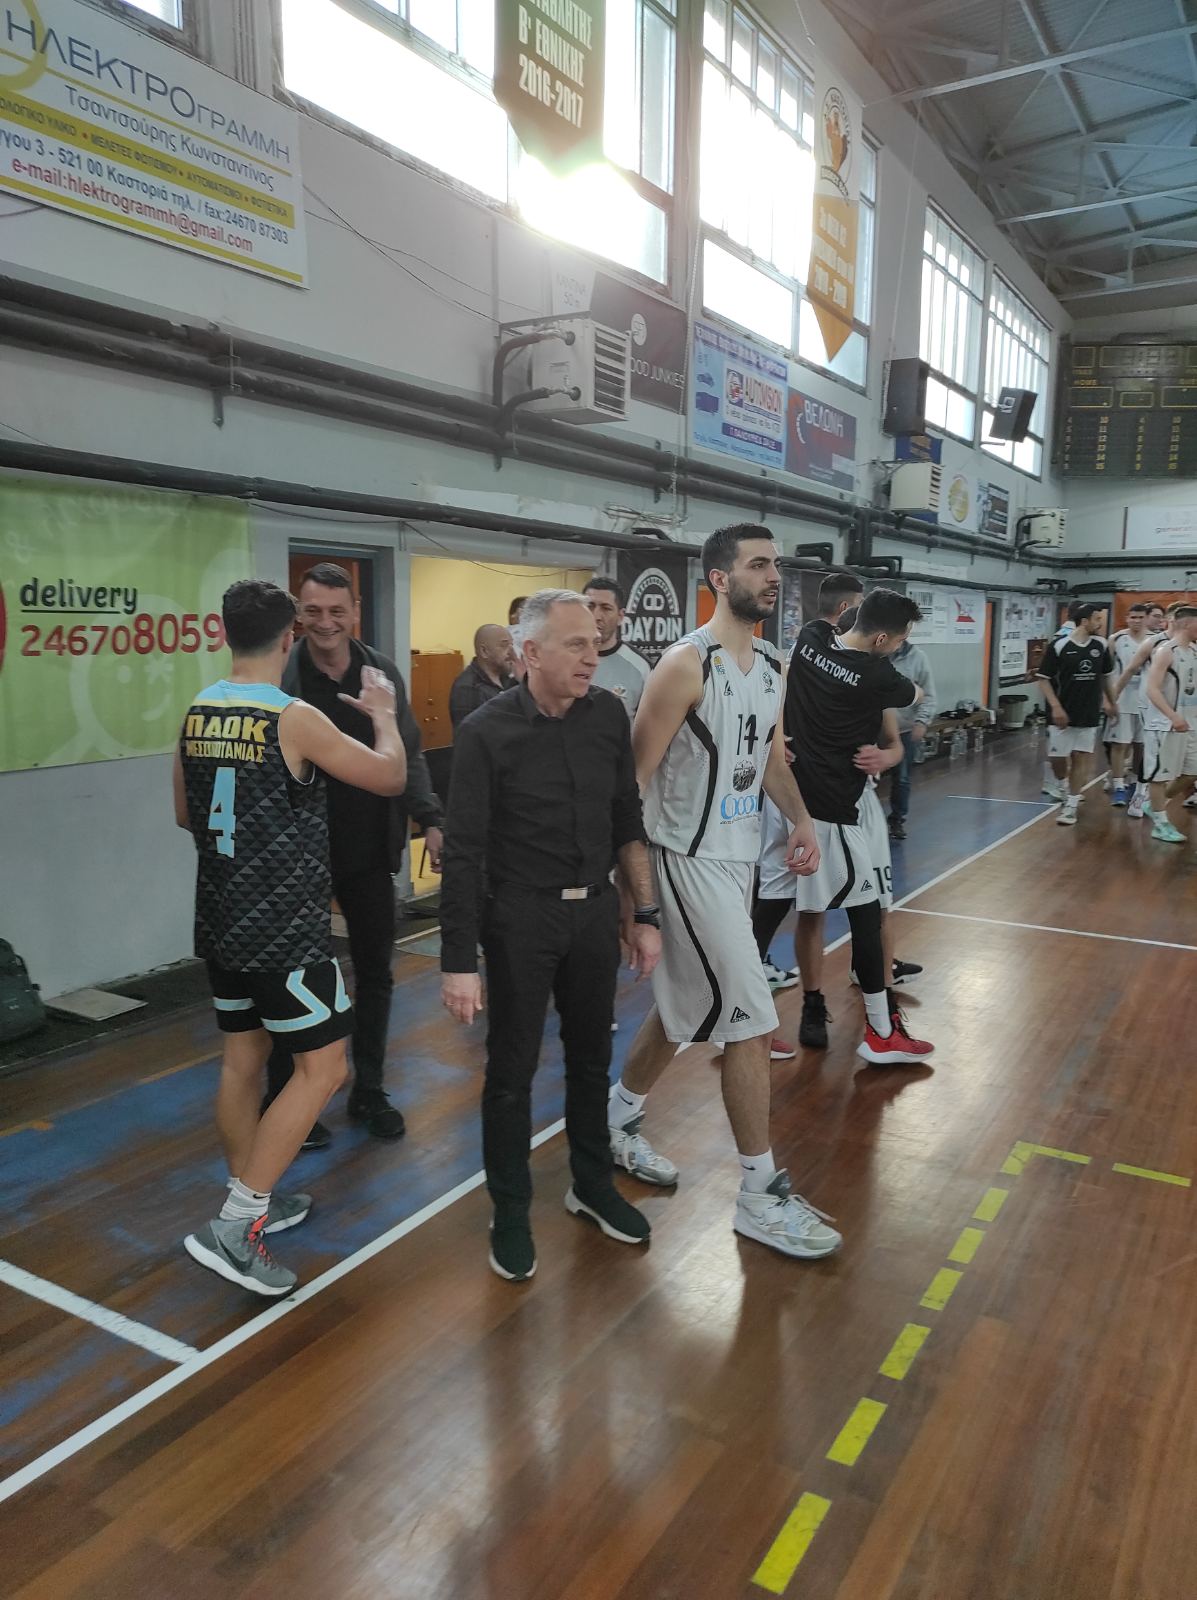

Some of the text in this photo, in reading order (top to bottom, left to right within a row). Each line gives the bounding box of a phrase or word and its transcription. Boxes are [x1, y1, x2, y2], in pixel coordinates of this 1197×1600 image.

[535, 17, 585, 88] ΕΘΝΙΚΗΣ
[6, 9, 291, 163] ΗΛΕΚΤΡΟΓΡΑΜΜΗ
[518, 53, 583, 129] 2016-2017
[36, 139, 45, 157] 3
[58, 147, 82, 170] 521
[87, 157, 103, 177] 00
[106, 164, 168, 201] Καστοριά
[64, 84, 274, 192] Τσαντσούρης Κωνσταντίνος
[12, 157, 253, 253] e-mail:hlektrogrammh@gmail.com
[20, 577, 138, 615] delivery
[621, 616, 655, 642] DAY
[814, 653, 861, 687] ΚΑΣΤΟΡΙΑΣ
[186, 714, 270, 743] ΠΑΟΚ
[737, 713, 759, 756] 14
[208, 766, 236, 859] 4
